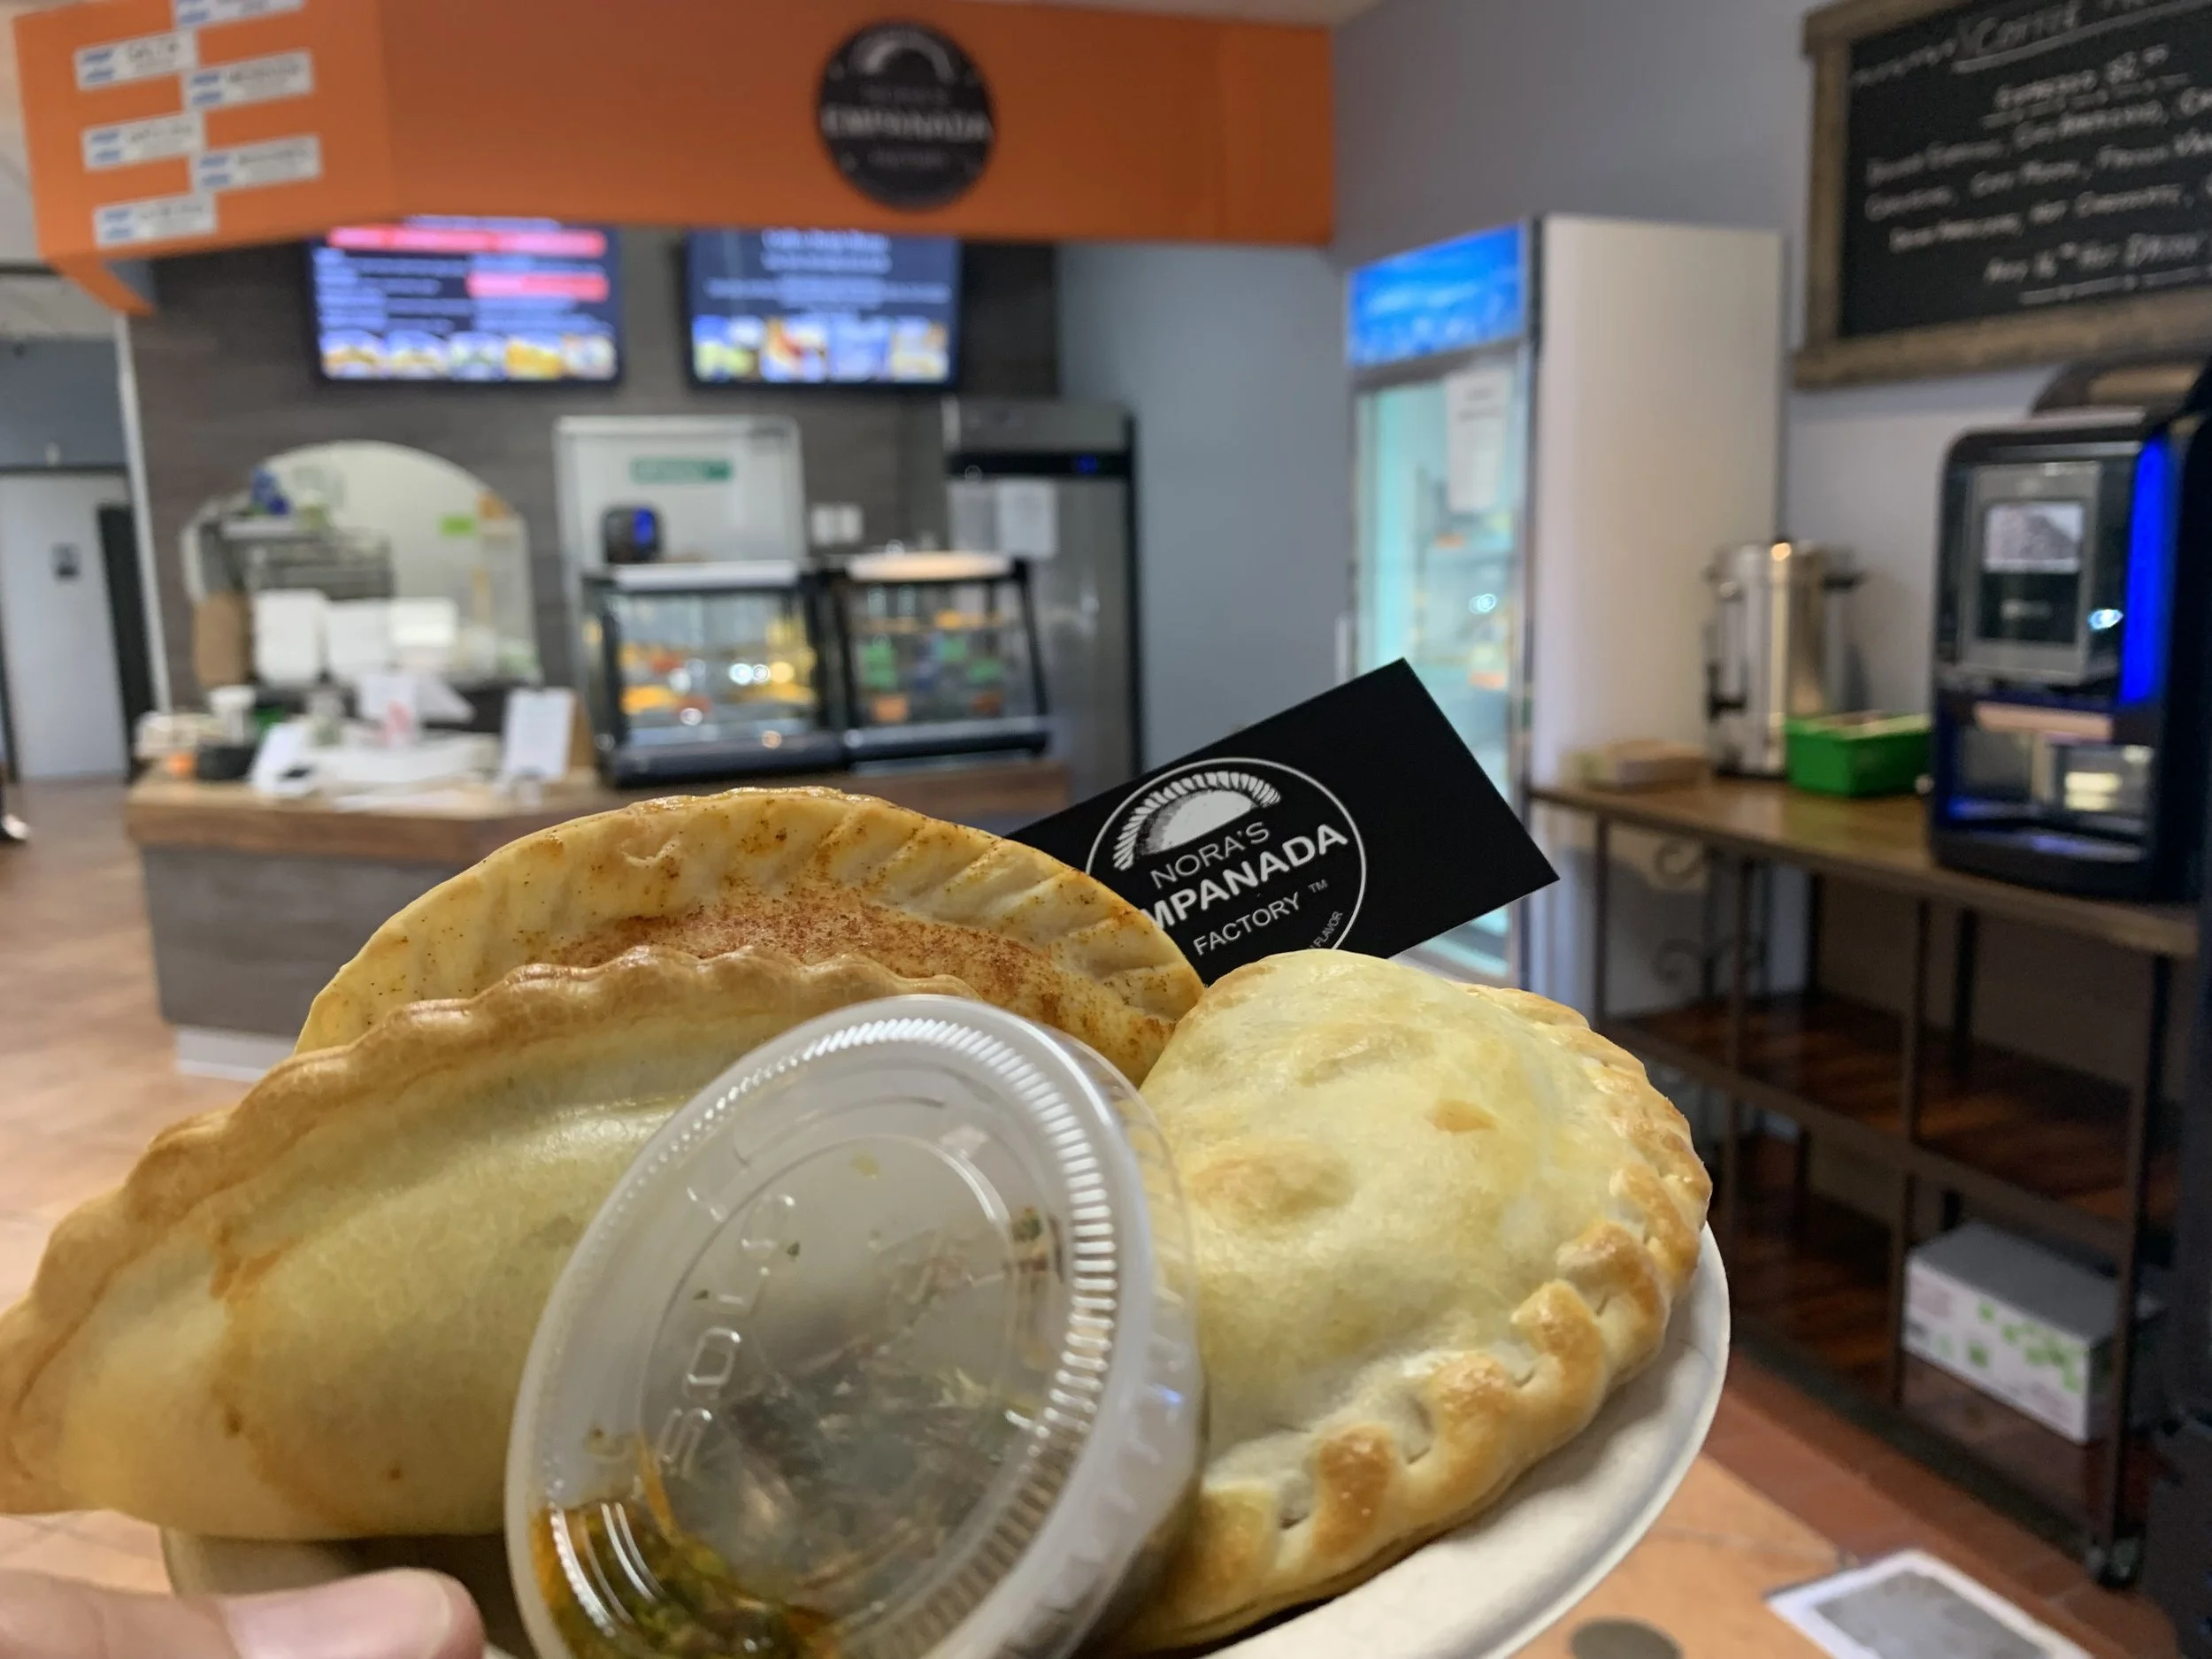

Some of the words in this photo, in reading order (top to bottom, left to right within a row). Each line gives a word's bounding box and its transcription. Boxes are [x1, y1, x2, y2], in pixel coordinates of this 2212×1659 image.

[1141, 824, 1348, 930] MPANADA
[1150, 821, 1270, 889] NORA'S
[1193, 891, 1301, 956] FACTORY
[1313, 911, 1343, 948] FLAVOR
